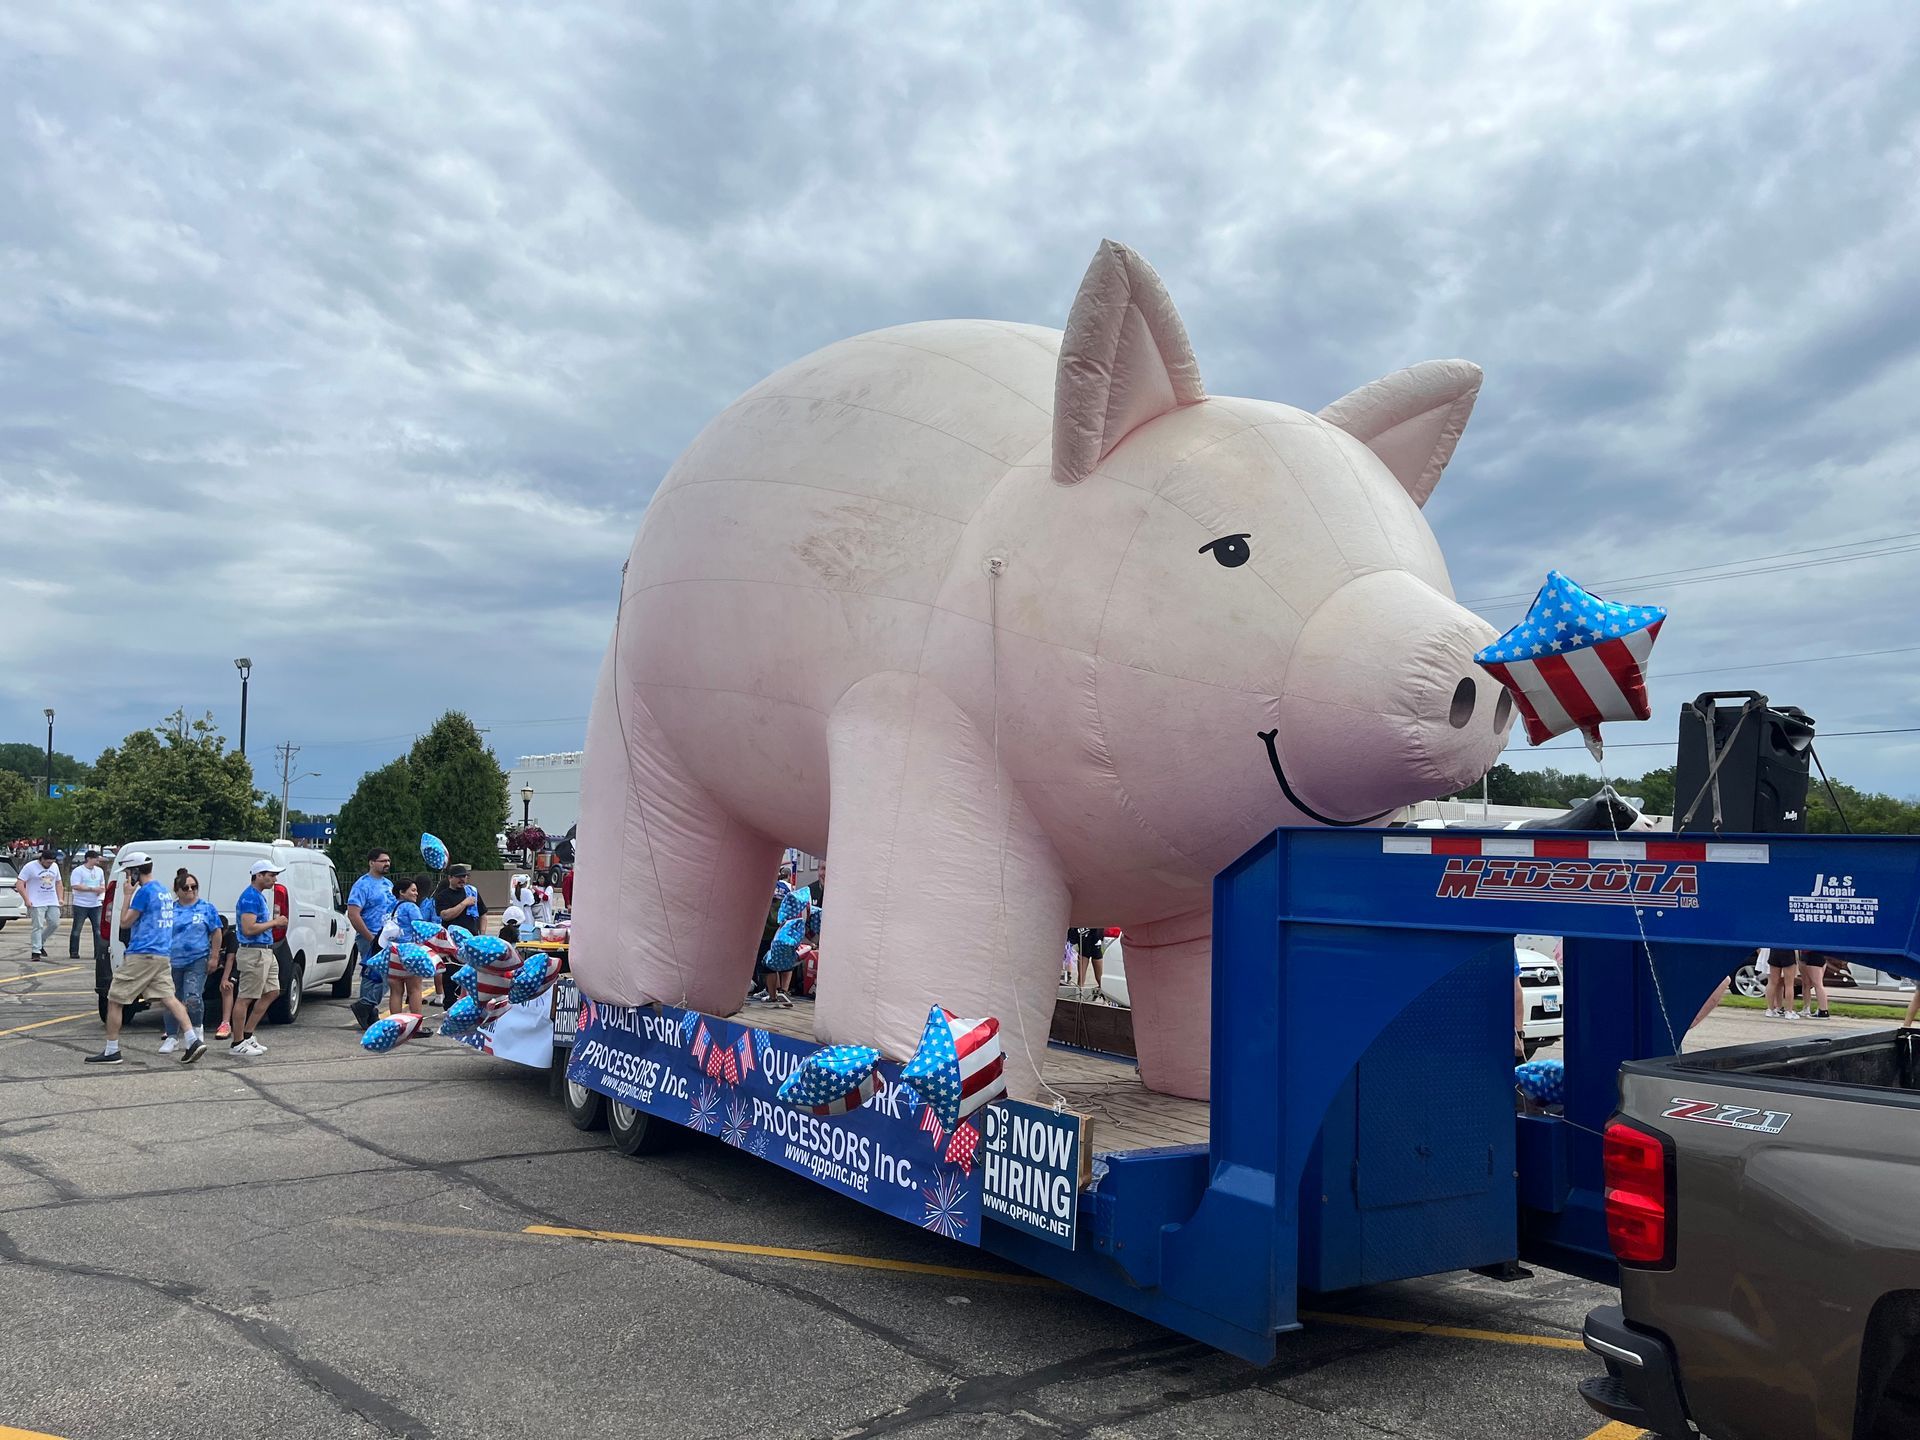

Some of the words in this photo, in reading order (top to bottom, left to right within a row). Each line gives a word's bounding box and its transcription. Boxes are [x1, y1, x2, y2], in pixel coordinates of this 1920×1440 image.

[1436, 859, 1699, 897] MIDSOTA
[1811, 873, 1824, 897] J
[1828, 876, 1839, 886] &
[1842, 875, 1852, 886] S
[1822, 886, 1856, 897] Repair
[1793, 914, 1875, 925] JSREPAIR.COM
[554, 1010, 579, 1034] HIRING
[642, 1015, 681, 1048] PORK
[580, 1040, 661, 1089] PROCESSORS
[660, 1066, 689, 1100] Inc.
[1661, 1097, 1793, 1132] Z71
[752, 1096, 871, 1173] PROCESSORS
[874, 1143, 918, 1191] Inc.
[1012, 1115, 1074, 1171] NOW
[784, 1143, 869, 1194] www.qppinc.net
[984, 1151, 1071, 1220] HIRING
[982, 1192, 1072, 1238] WWW.QPPINC.NET
